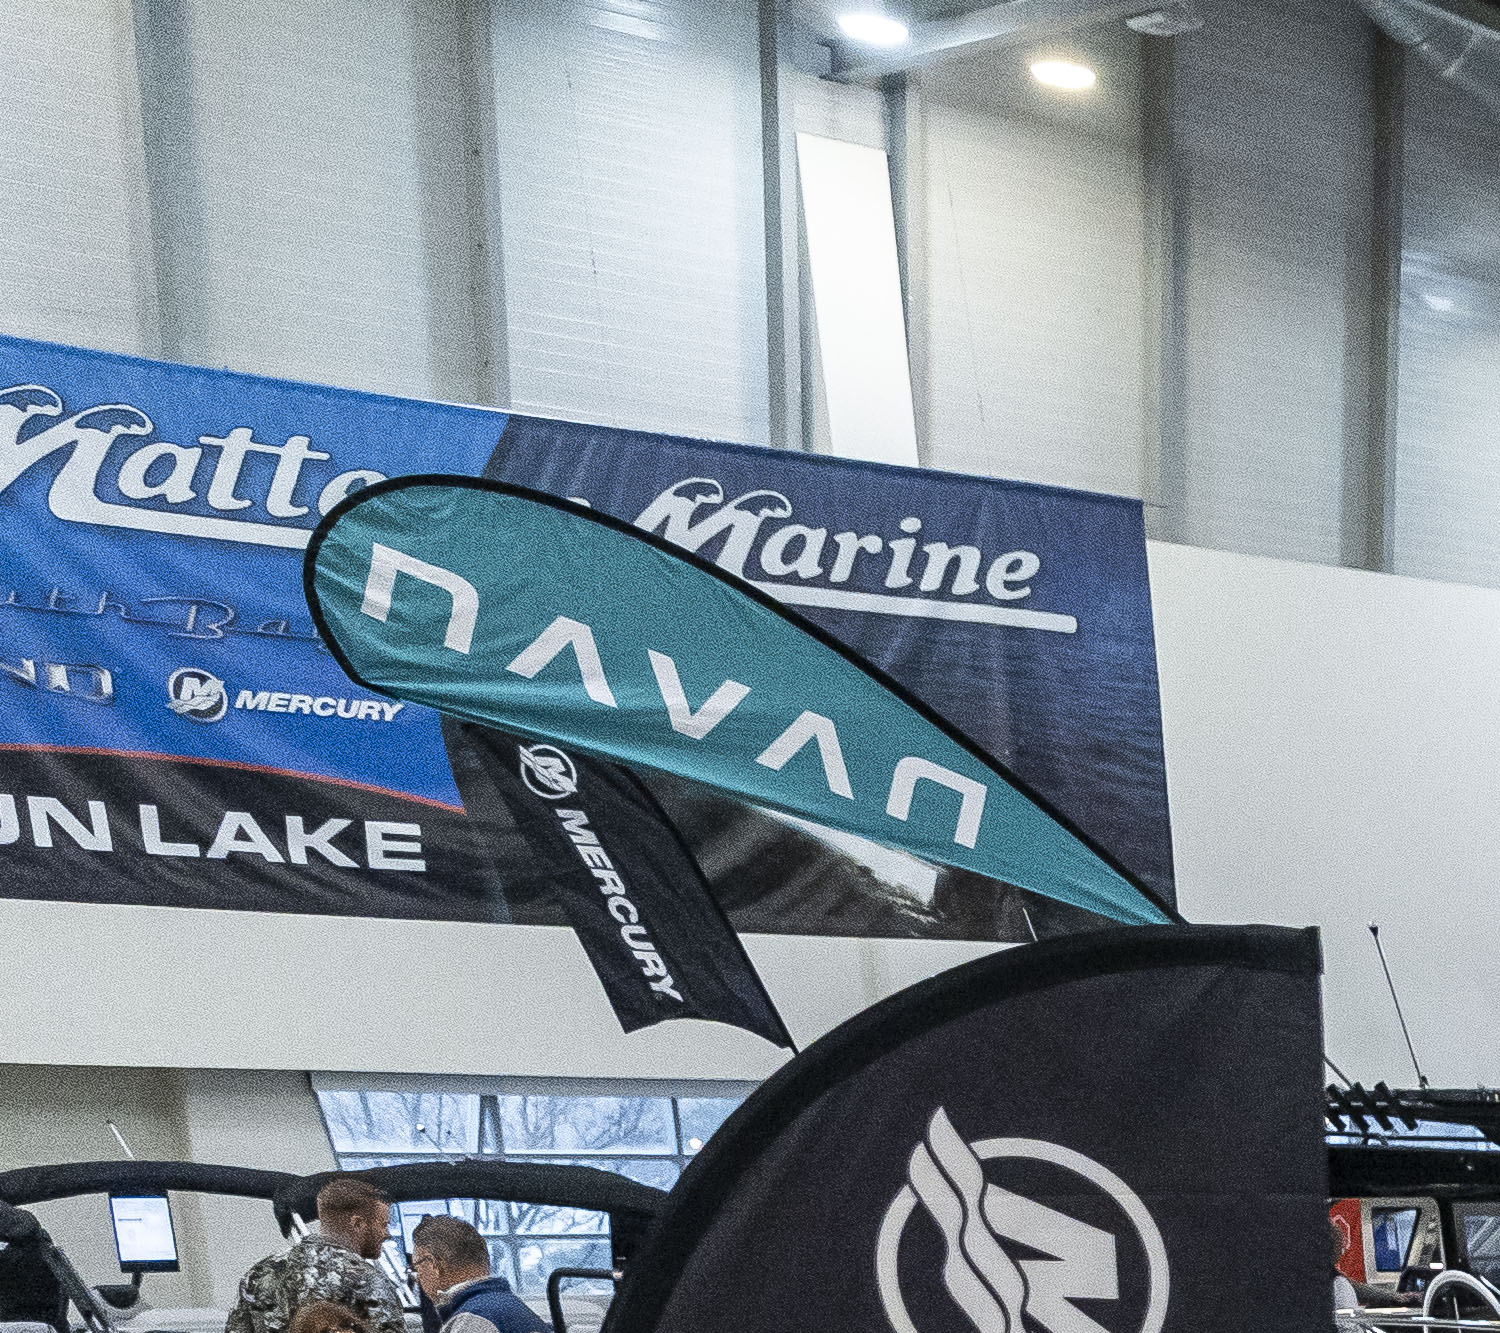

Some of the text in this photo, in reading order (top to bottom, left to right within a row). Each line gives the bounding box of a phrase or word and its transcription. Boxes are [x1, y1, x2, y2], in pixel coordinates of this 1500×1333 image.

[234, 690, 403, 722] MERCURY
[138, 803, 426, 872] LAKE
[555, 808, 683, 1002] MERCURY
